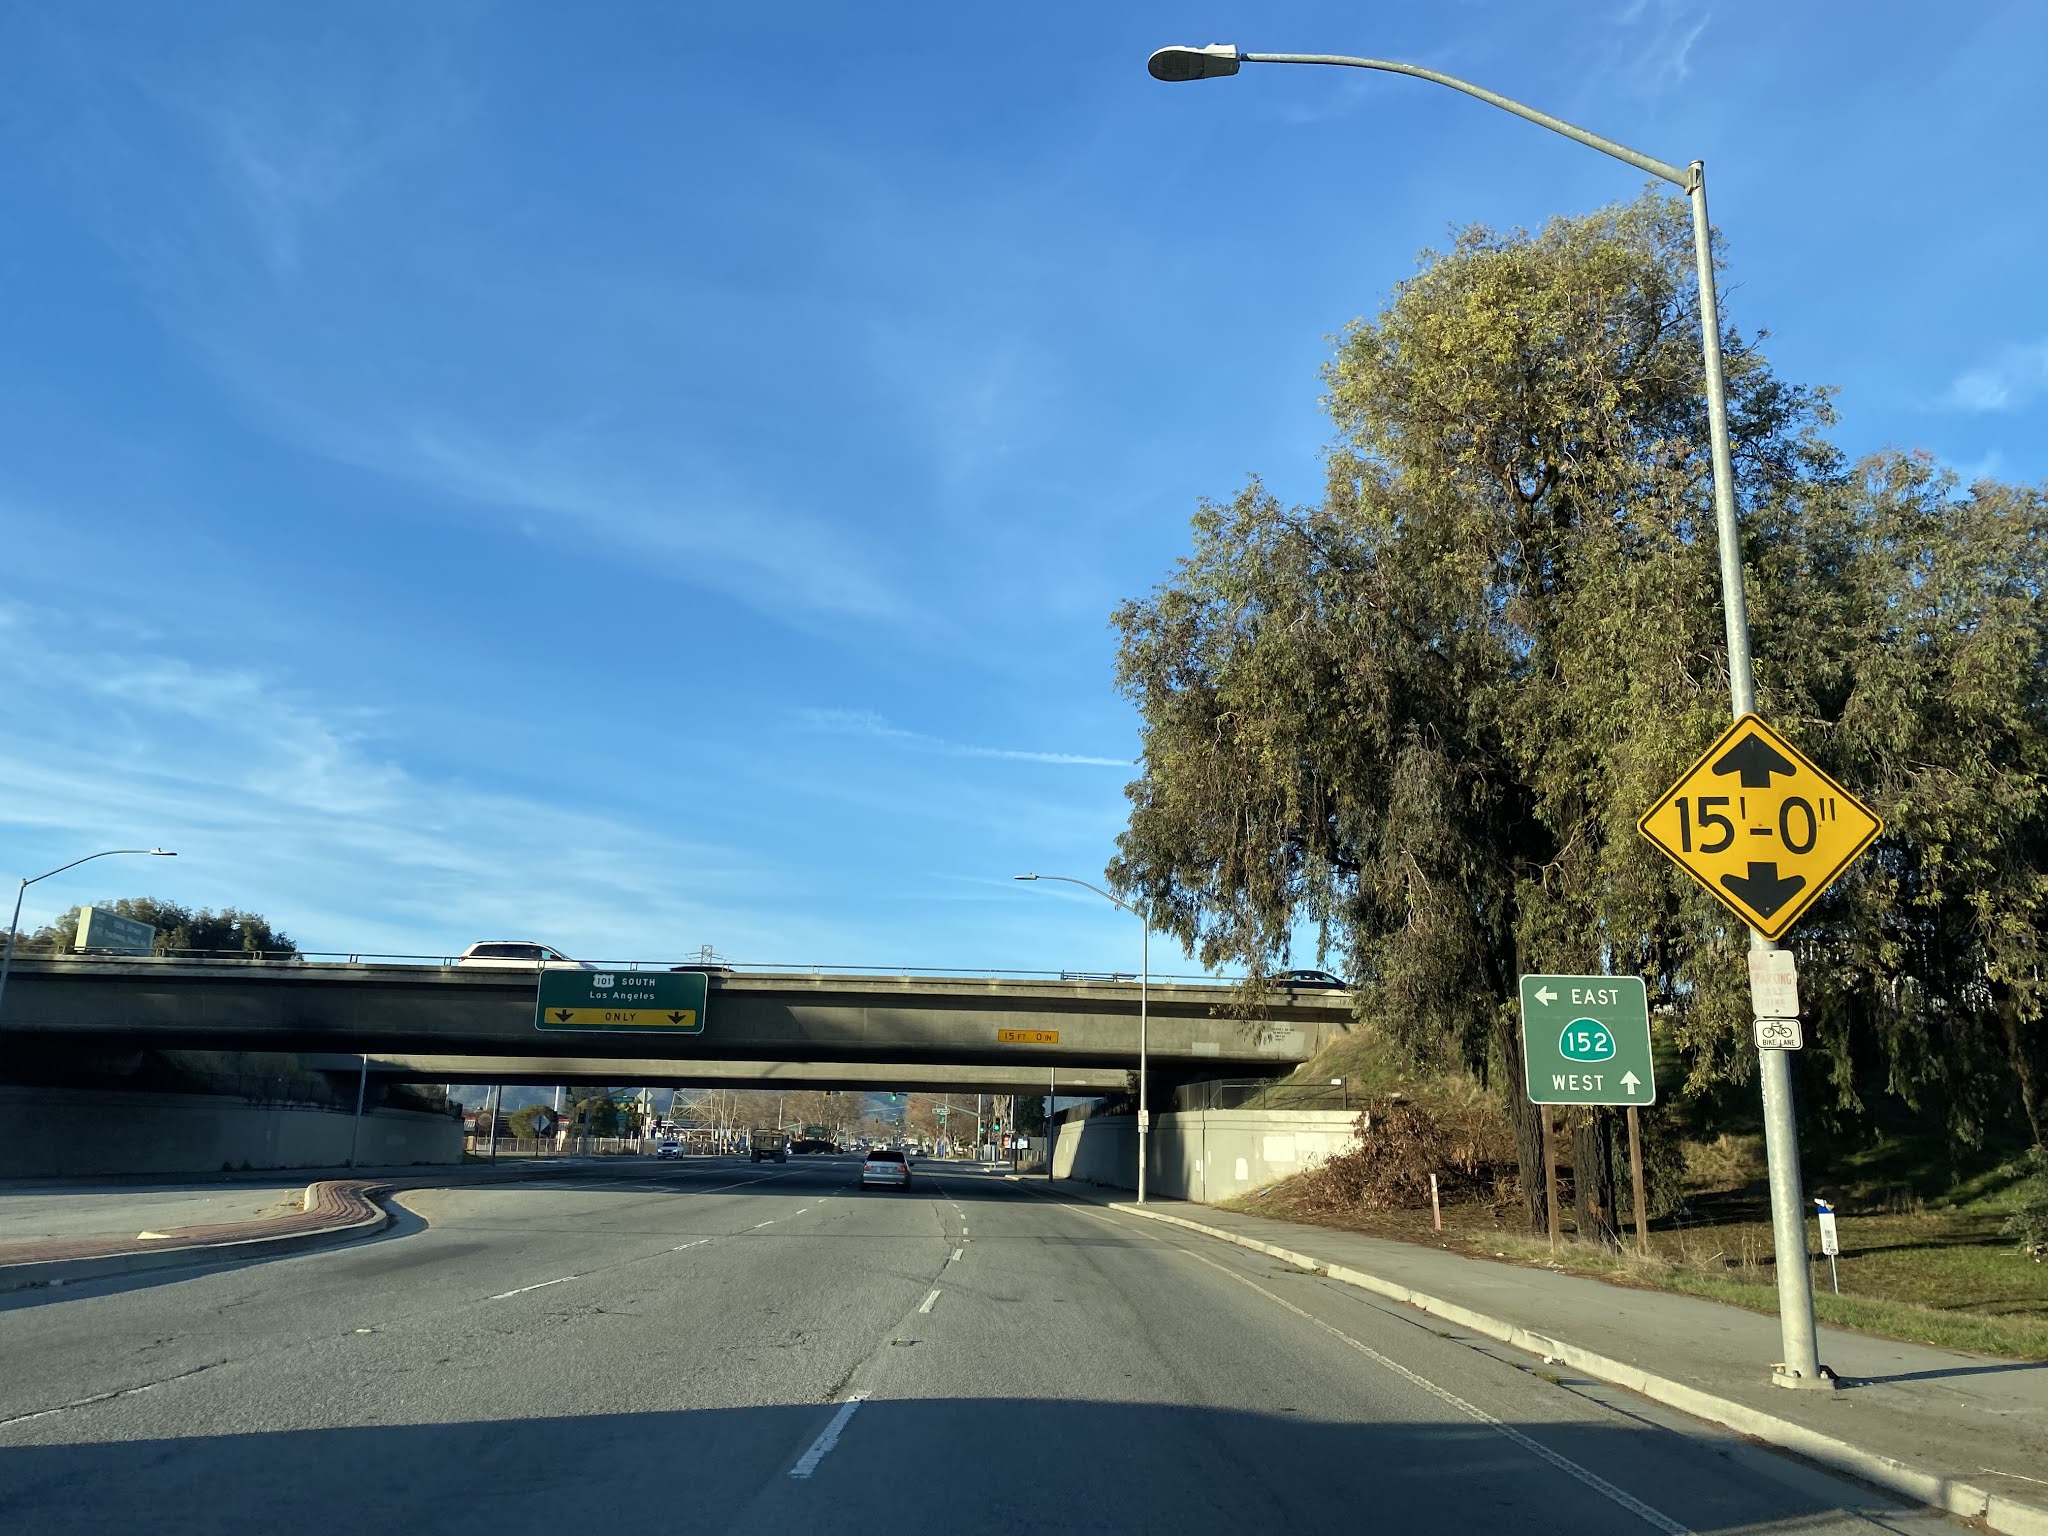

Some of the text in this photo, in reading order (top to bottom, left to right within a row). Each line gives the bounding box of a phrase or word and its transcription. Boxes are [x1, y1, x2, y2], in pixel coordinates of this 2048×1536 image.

[597, 977, 656, 986] 101 SOUTH
[613, 991, 655, 1001] Angeles
[1571, 988, 1619, 1005] EAST
[605, 1012, 636, 1021] ONLY
[1004, 1032, 1015, 1041] 15
[1017, 1033, 1026, 1041] FT
[1045, 1034, 1052, 1042] IN
[1567, 1032, 1609, 1052] 152
[1780, 1039, 1796, 1047] LANE
[1552, 1074, 1604, 1091] WEST
